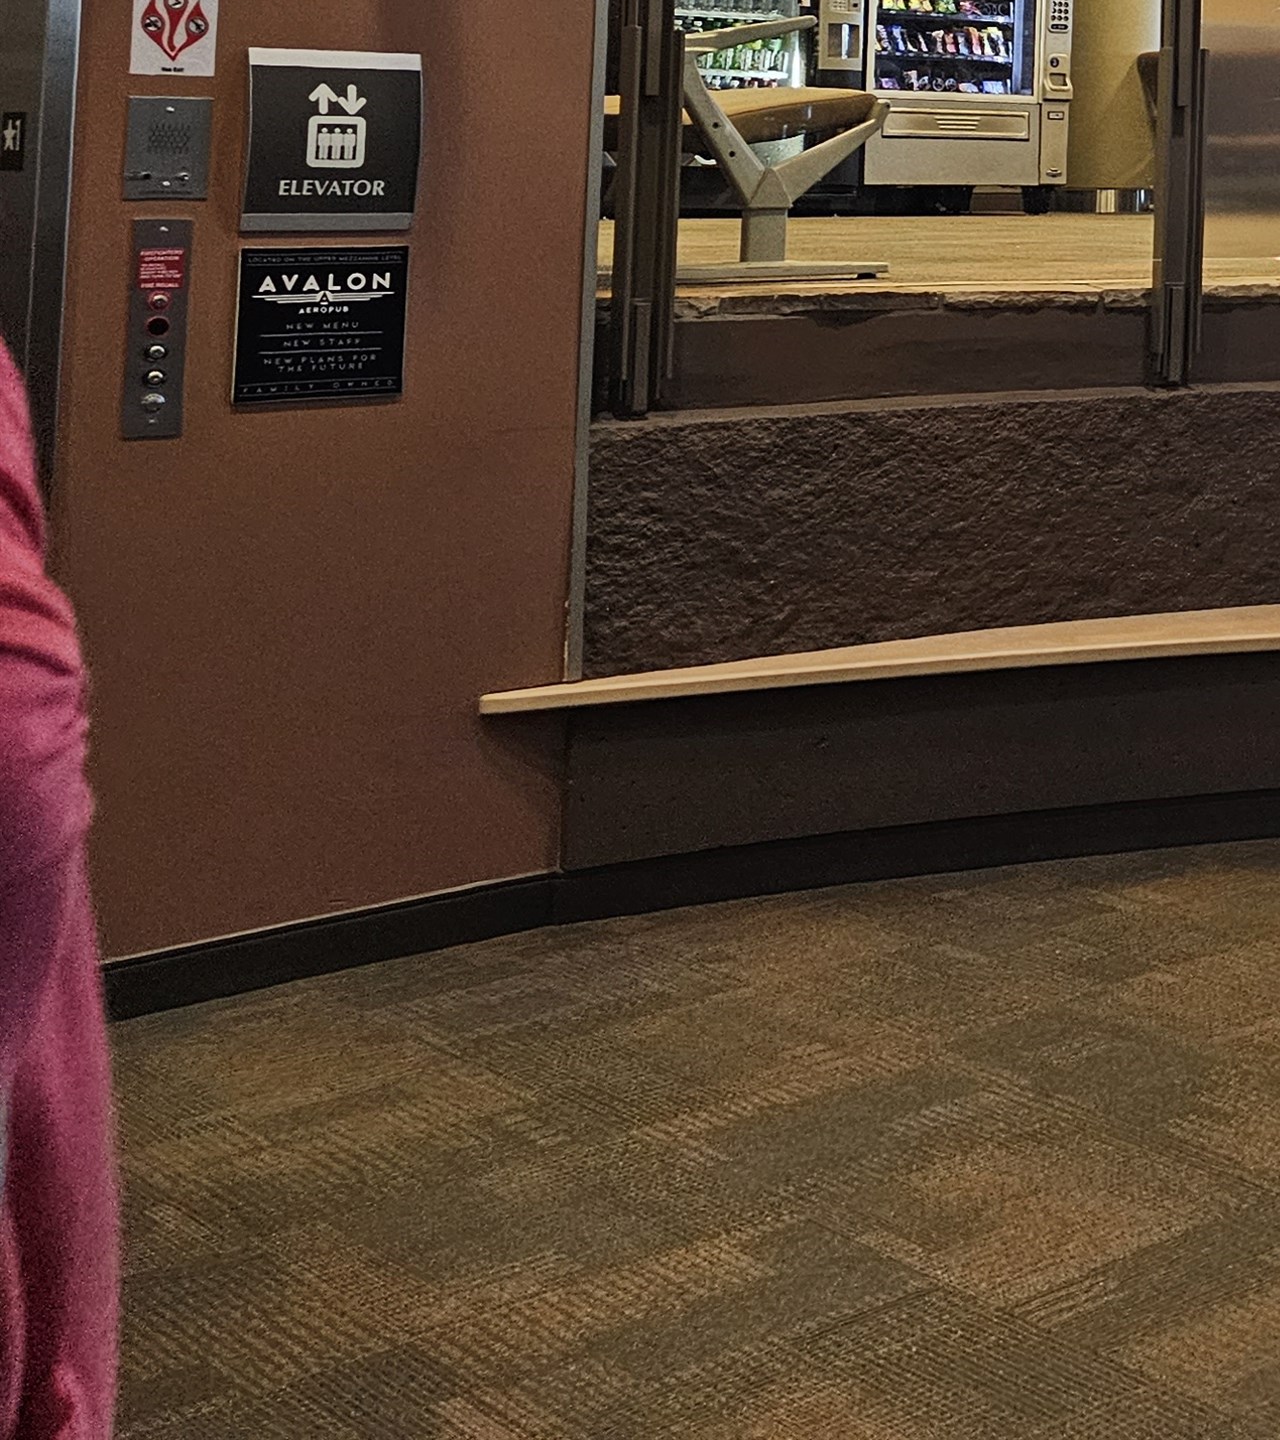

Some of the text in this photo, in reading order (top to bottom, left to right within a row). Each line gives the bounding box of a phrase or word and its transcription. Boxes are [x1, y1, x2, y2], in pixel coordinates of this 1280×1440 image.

[278, 179, 385, 197] ELEVATOR
[258, 272, 391, 293] AVALON
[298, 306, 349, 314] AEROPUB
[286, 321, 359, 330] NEW MENU
[283, 338, 361, 347] NEW STAFF
[263, 357, 292, 365] NEW
[301, 355, 343, 364] PLANS
[312, 363, 363, 371] FUTURE
[243, 383, 314, 393] FAMILY
